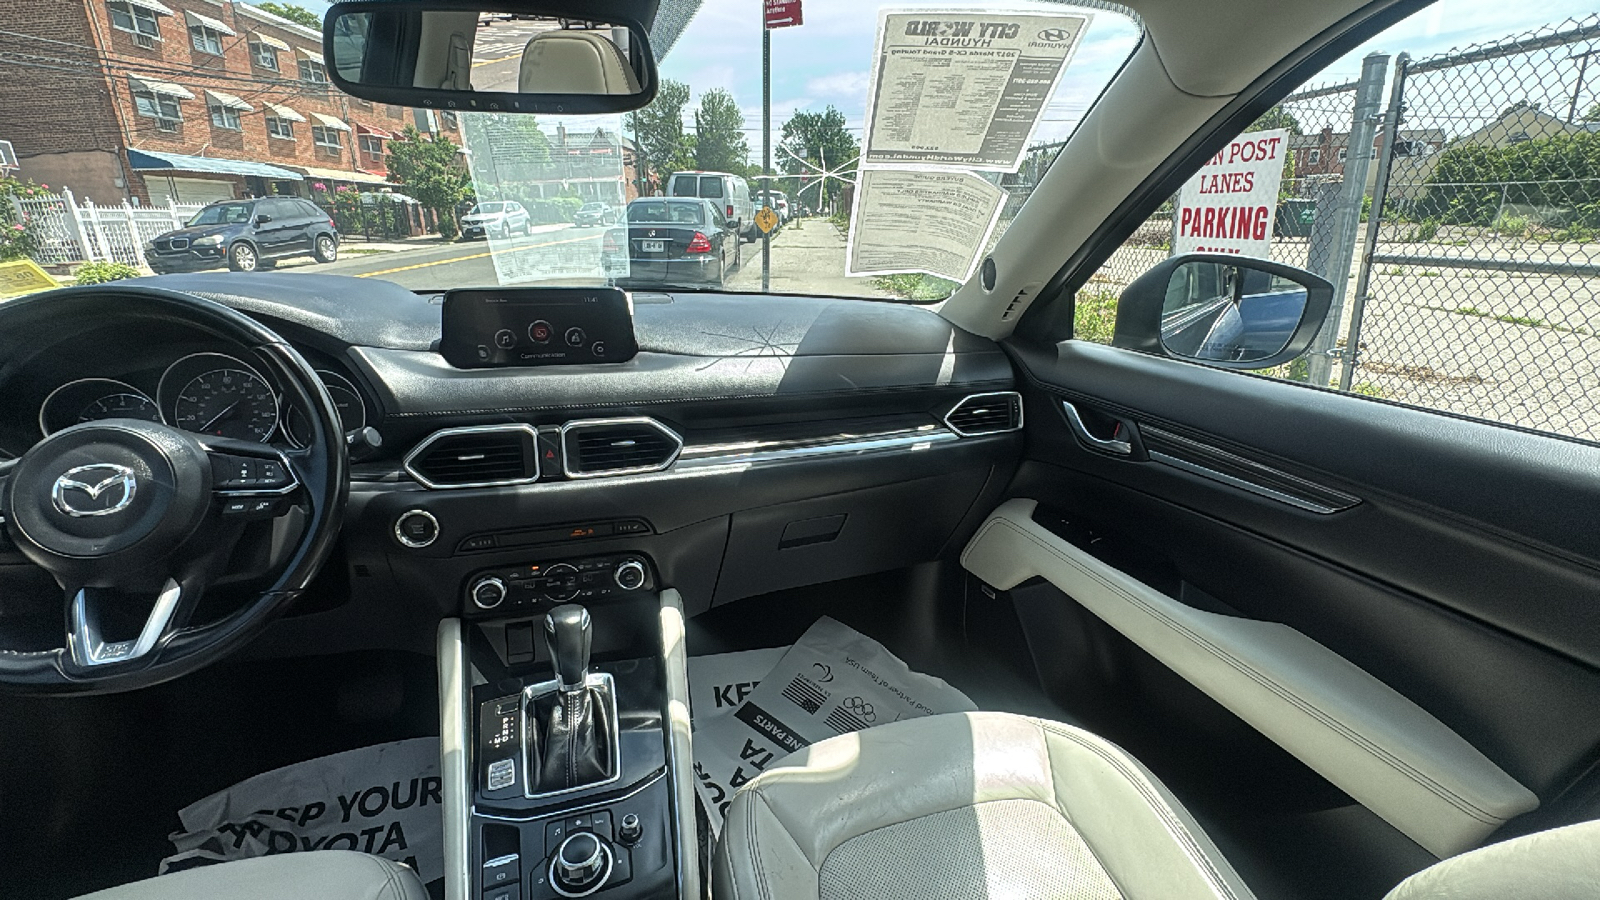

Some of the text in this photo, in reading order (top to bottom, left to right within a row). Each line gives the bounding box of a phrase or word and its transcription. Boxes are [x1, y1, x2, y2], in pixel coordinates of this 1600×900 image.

[1228, 137, 1280, 164] POST
[1200, 172, 1254, 194] LANES
[1180, 206, 1268, 240] PARKING
[520, 352, 566, 360] Communication
[845, 657, 934, 715] roud Partner of Team USA
[754, 715, 785, 738] PARTS
[338, 776, 442, 823] YOUR
[265, 822, 408, 854] OYOTA
